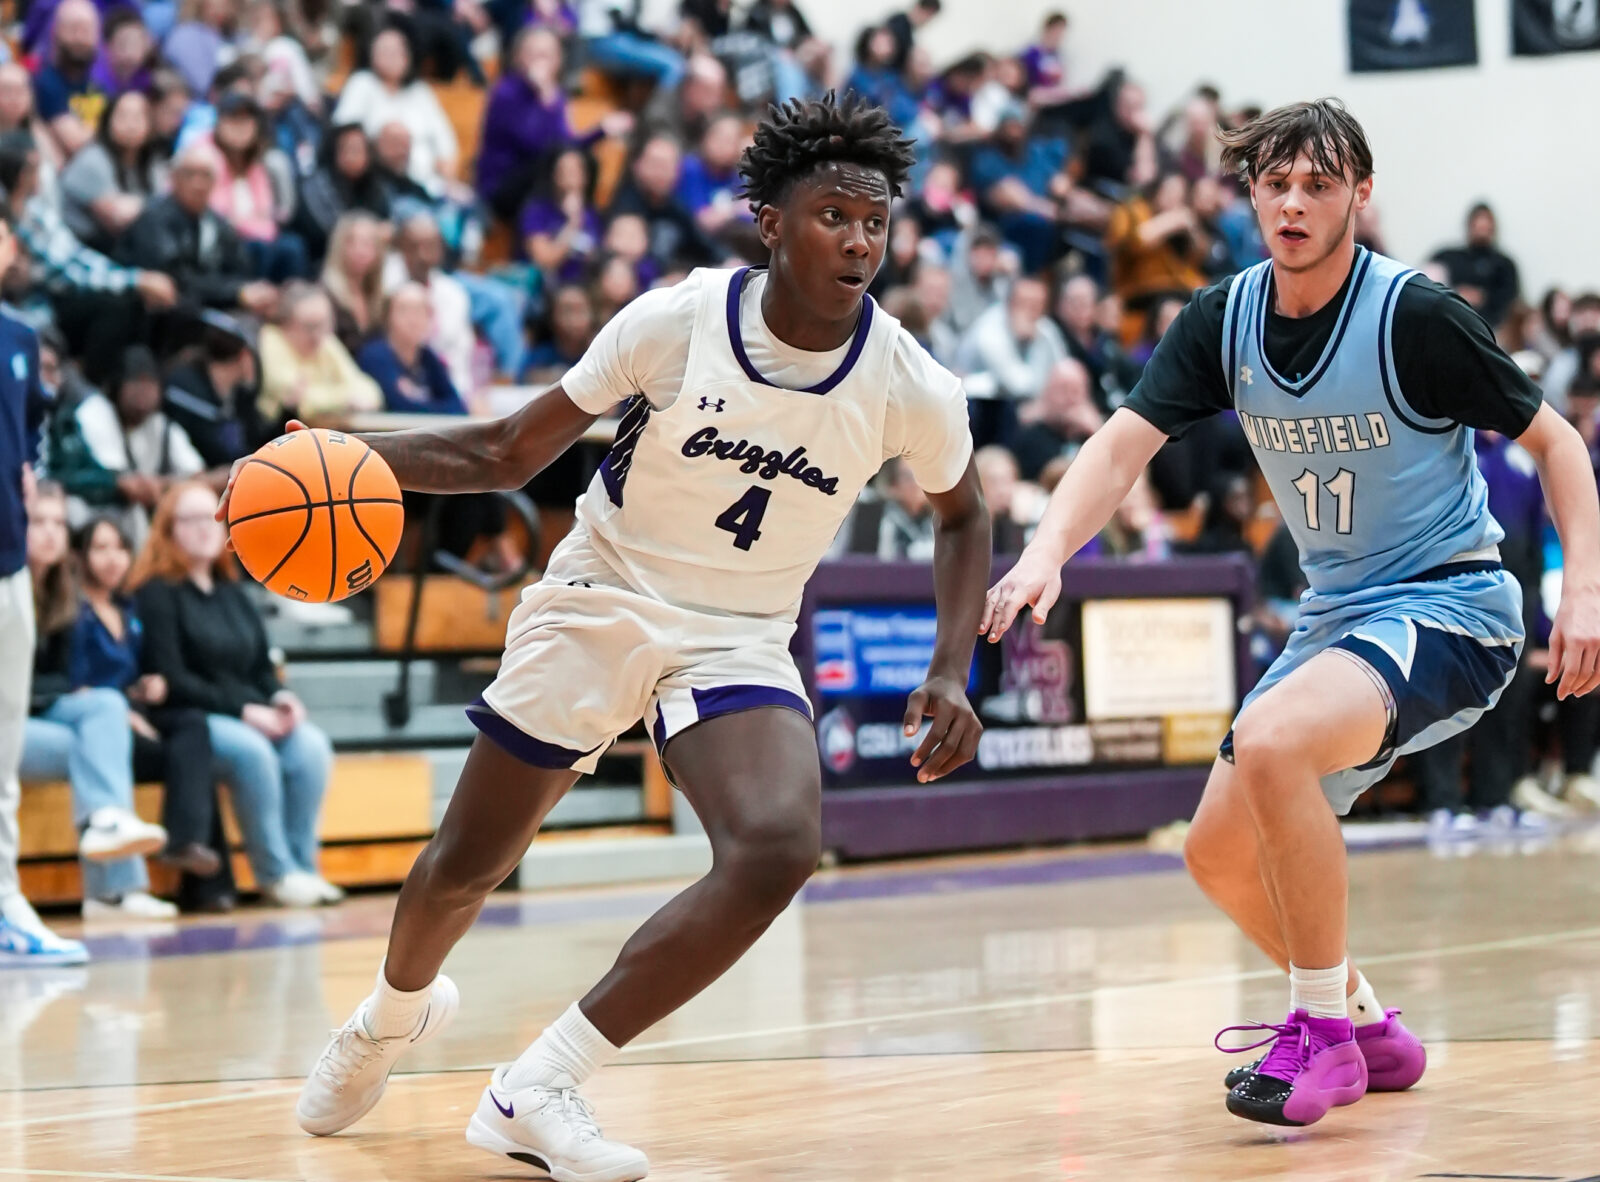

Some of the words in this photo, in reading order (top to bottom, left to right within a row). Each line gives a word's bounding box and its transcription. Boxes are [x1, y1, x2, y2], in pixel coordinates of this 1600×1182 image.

[681, 426, 839, 495] Grizzlies
[1239, 410, 1391, 454] WIDEFIELD
[714, 485, 772, 551] 4
[1291, 467, 1356, 535] 11
